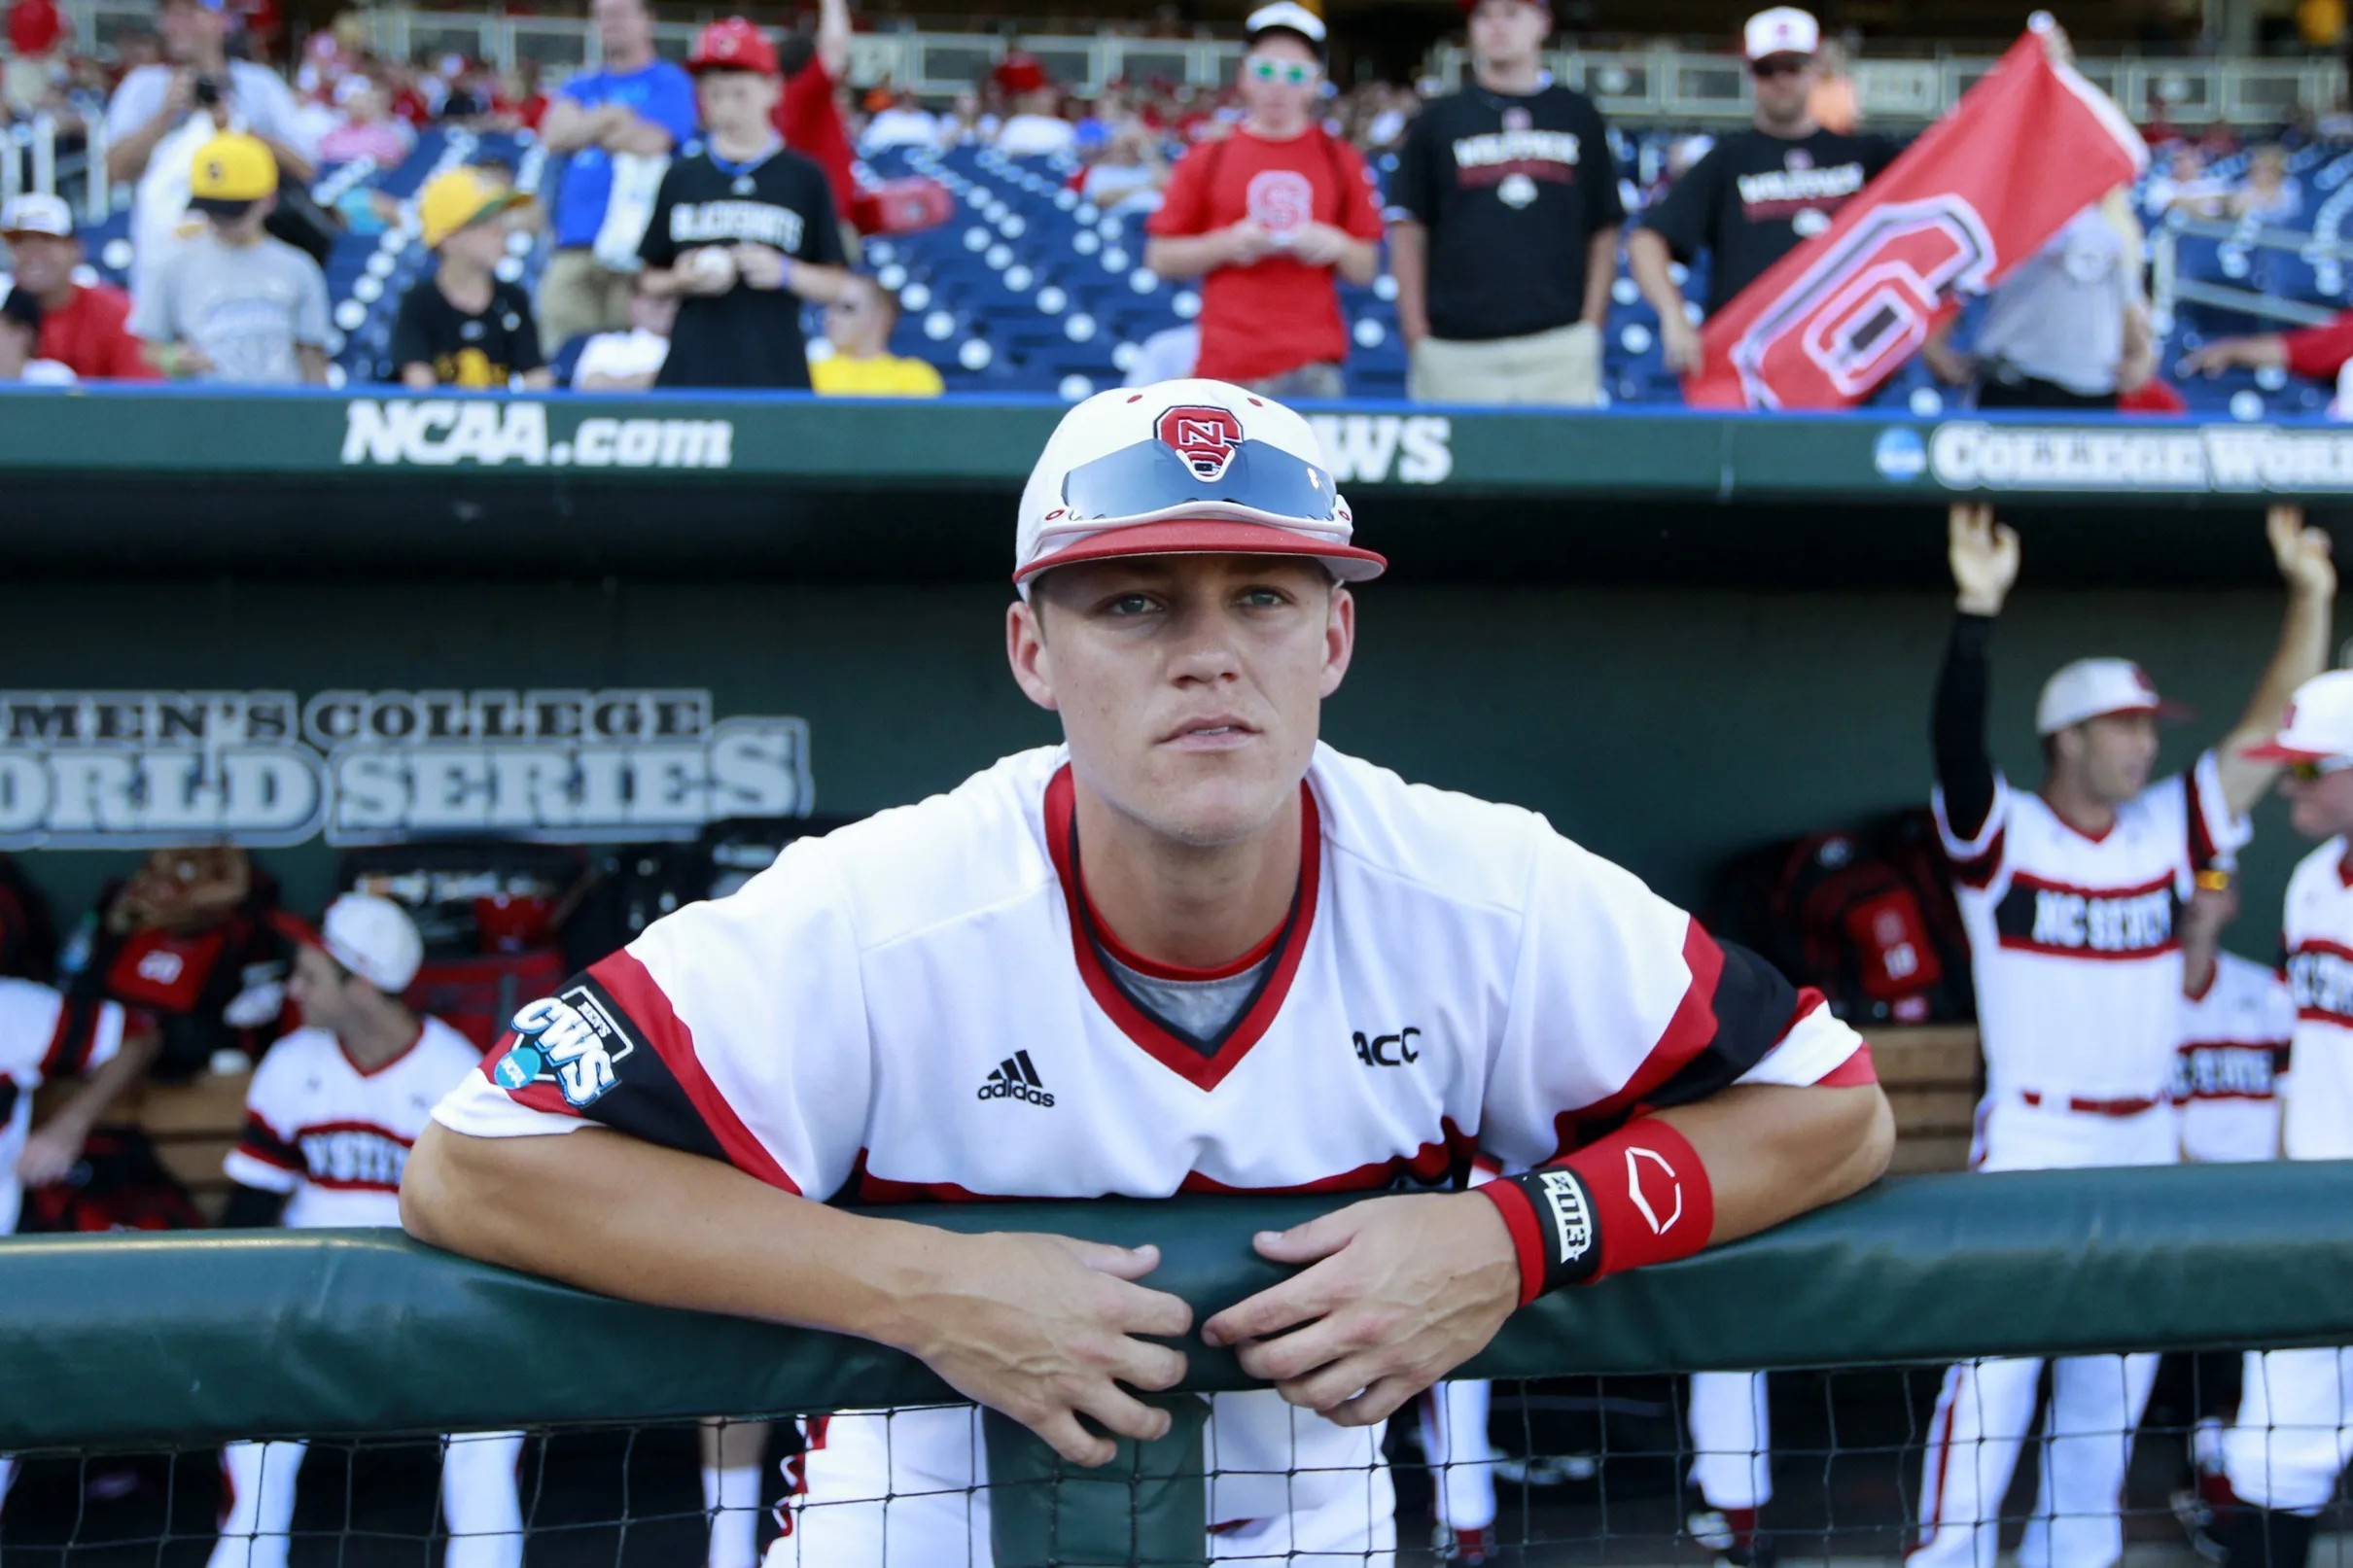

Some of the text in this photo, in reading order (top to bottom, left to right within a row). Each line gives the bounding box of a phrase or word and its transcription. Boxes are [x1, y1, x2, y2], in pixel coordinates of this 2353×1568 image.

[340, 399, 732, 468] NCAA.com
[1309, 414, 1453, 484] WS
[9, 702, 700, 739] MEN'S COLLEGE
[0, 731, 799, 832] ORLD SERIES
[511, 996, 618, 1107] CWS
[1352, 1027, 1421, 1066] ACC
[977, 1078, 1054, 1107] adidas
[1552, 1176, 1586, 1247] 2013
